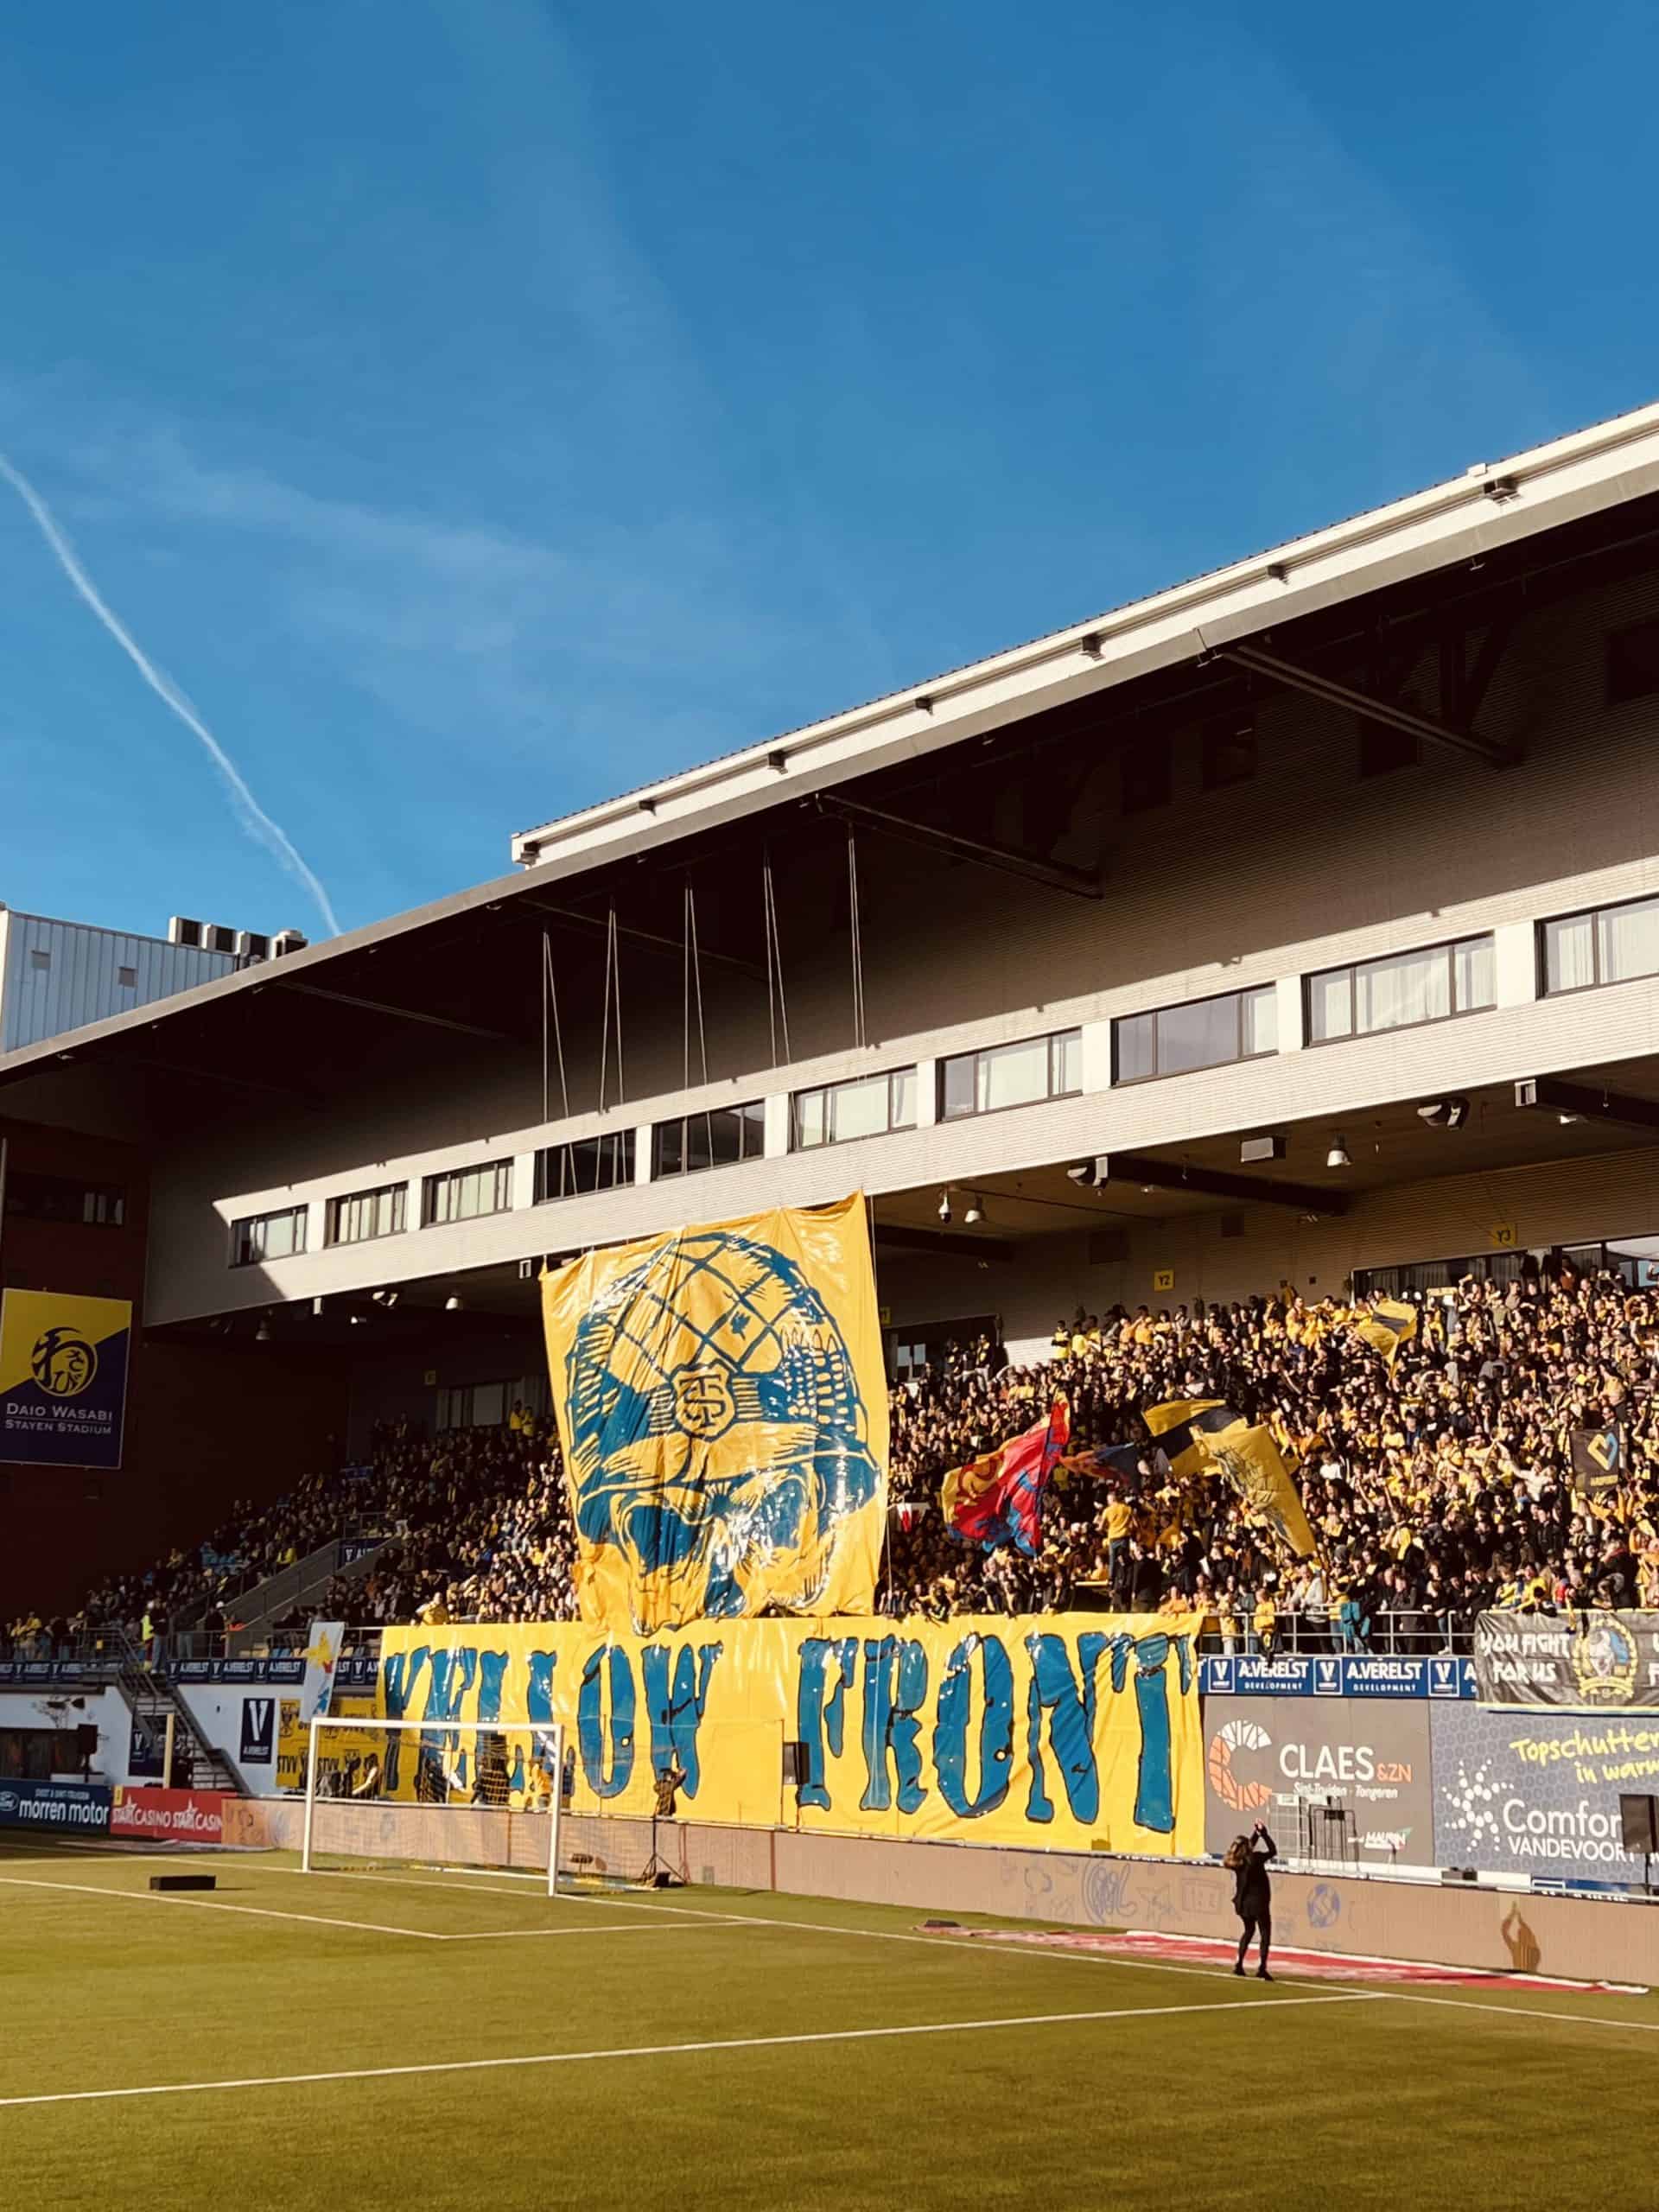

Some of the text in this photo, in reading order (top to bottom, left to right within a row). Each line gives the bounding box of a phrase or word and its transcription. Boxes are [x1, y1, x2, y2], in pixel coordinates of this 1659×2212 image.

[1480, 1631, 1570, 1658] YOU FIGHT
[1347, 1662, 1423, 1680] A.VERELST
[1532, 1662, 1555, 1681] US
[1353, 1683, 1416, 1692] DEVELOPMENT
[385, 1631, 1192, 1833] YELLOW FRONT
[1279, 1744, 1413, 1784] CLAES &ZN
[1573, 1760, 1598, 1783] in
[19, 1799, 66, 1821] morren
[68, 1802, 110, 1825] motor
[1503, 1798, 1622, 1838] Comfor
